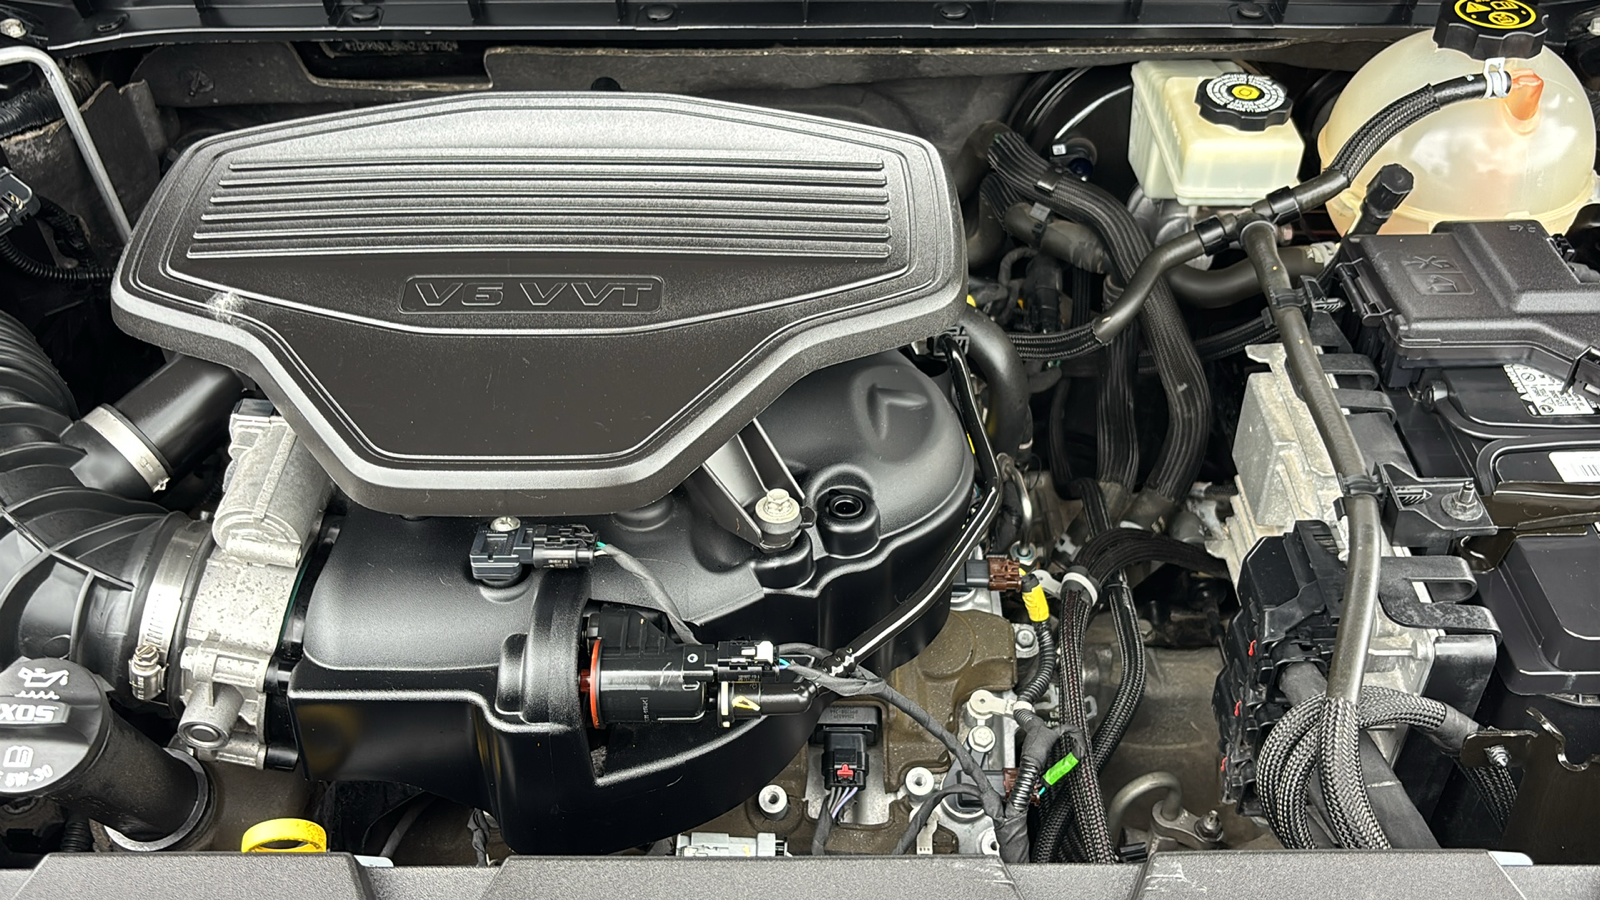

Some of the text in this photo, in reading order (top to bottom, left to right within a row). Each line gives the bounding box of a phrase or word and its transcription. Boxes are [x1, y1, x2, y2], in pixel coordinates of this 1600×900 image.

[415, 282, 653, 306] V6 VVT
[5, 764, 54, 787] 5W-30
